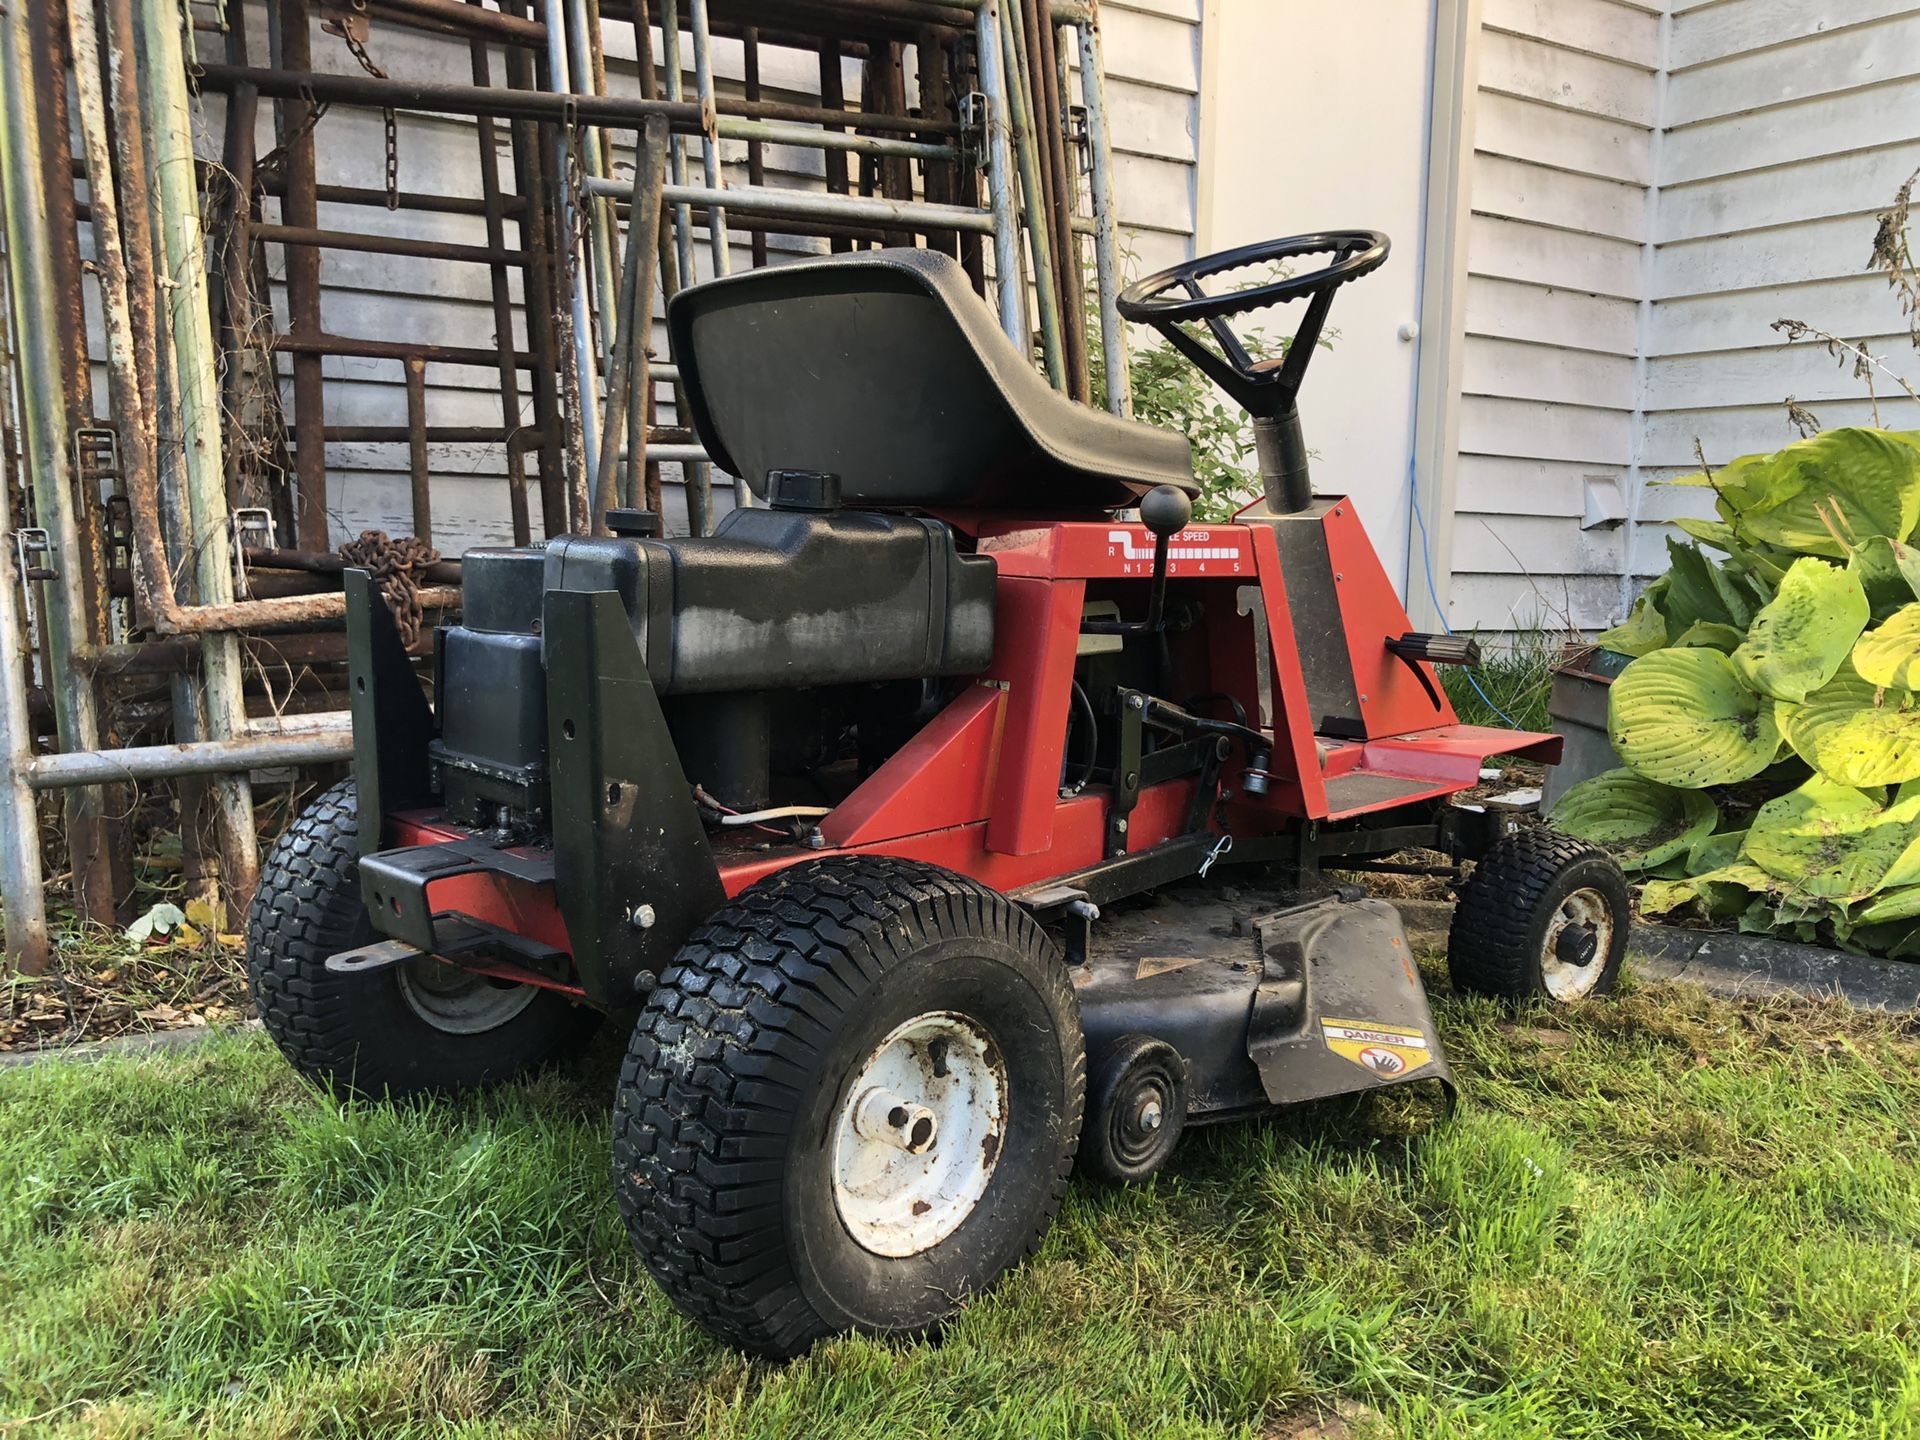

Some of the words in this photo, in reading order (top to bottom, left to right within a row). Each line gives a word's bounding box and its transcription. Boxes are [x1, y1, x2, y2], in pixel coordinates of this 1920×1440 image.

[1144, 531, 1180, 542] VELE
[1182, 531, 1210, 542] SPEED
[1108, 546, 1115, 557] R
[1123, 563, 1131, 573] N
[1136, 563, 1141, 573] 1
[1149, 563, 1155, 573] 2
[1169, 563, 1177, 573] 3
[1199, 563, 1205, 573] 4
[1233, 563, 1240, 572] 5
[1343, 1030, 1406, 1044] DANGER
